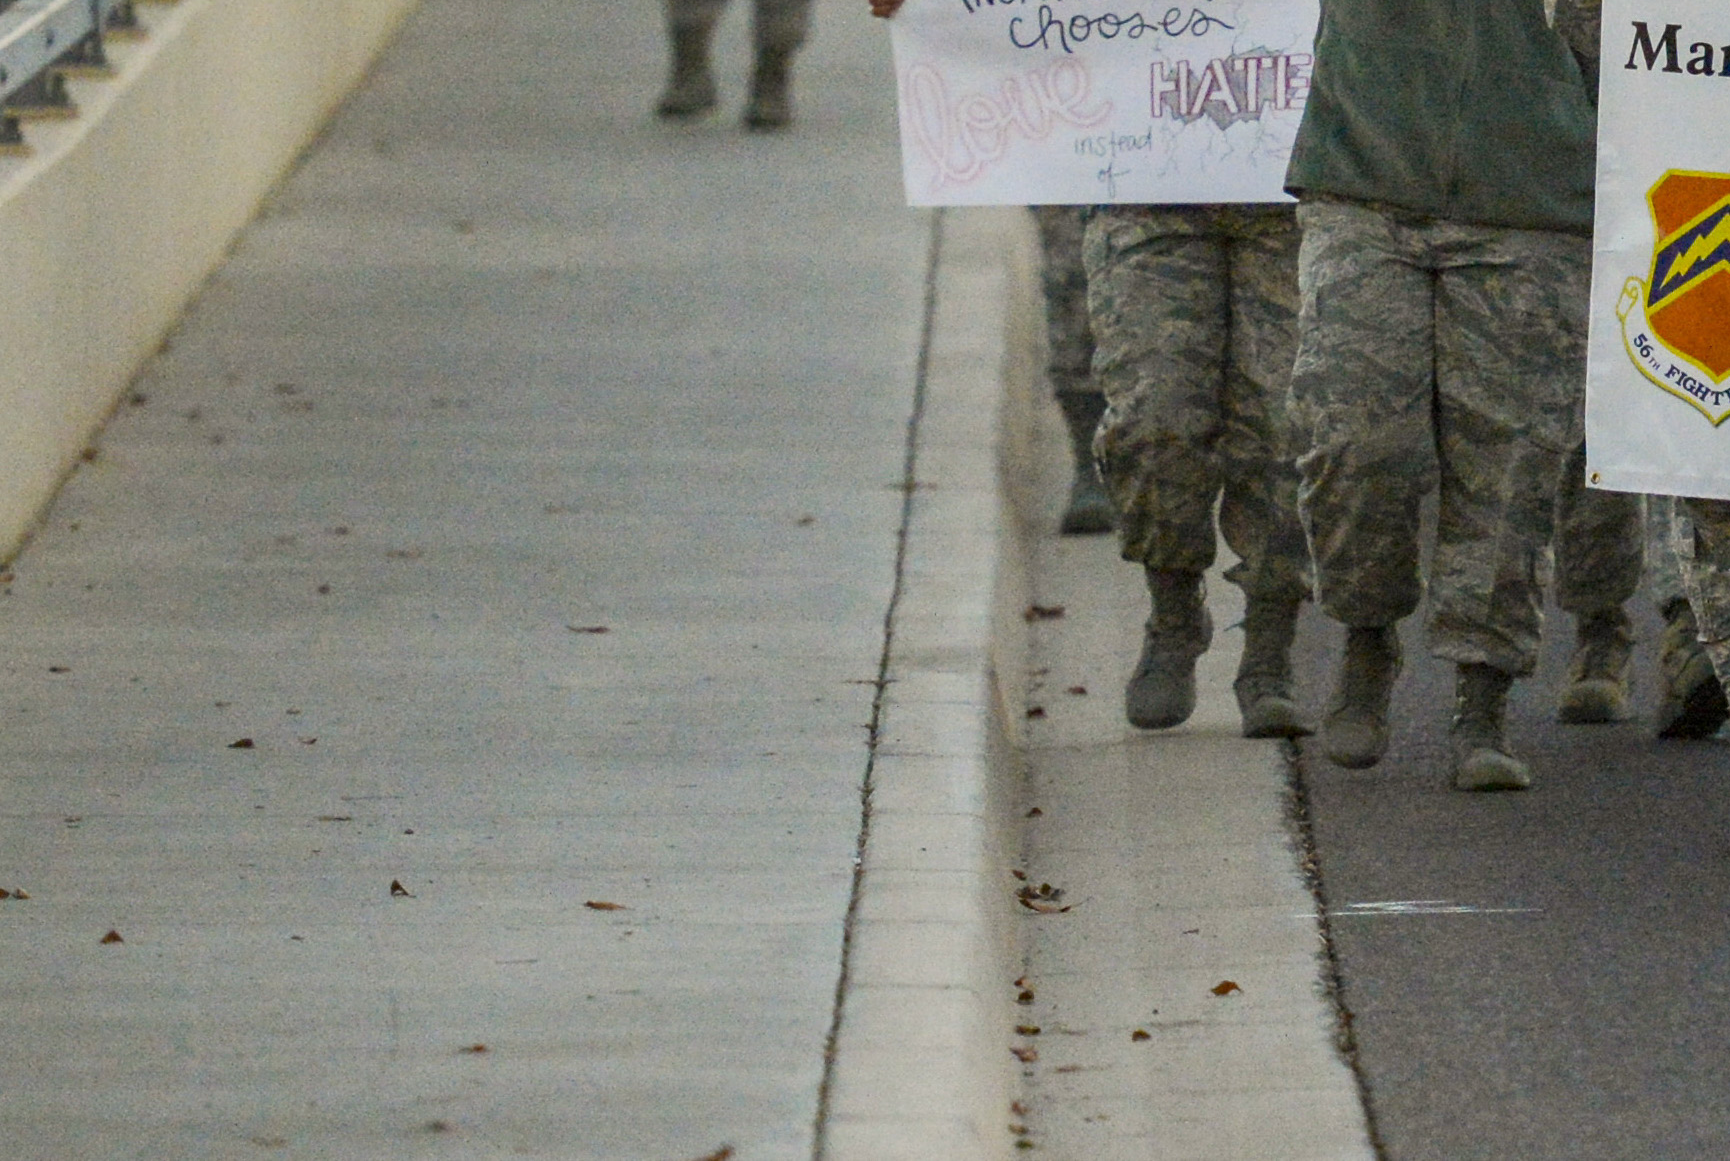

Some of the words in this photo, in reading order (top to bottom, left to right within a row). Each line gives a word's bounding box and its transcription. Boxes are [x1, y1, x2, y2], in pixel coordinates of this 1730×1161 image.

[1010, 5, 1235, 55] chooses
[1150, 53, 1313, 119] HATE
[903, 56, 1112, 195] love
[1074, 125, 1153, 157] instead
[1097, 162, 1132, 199] of
[1633, 333, 1661, 371] 56TH
